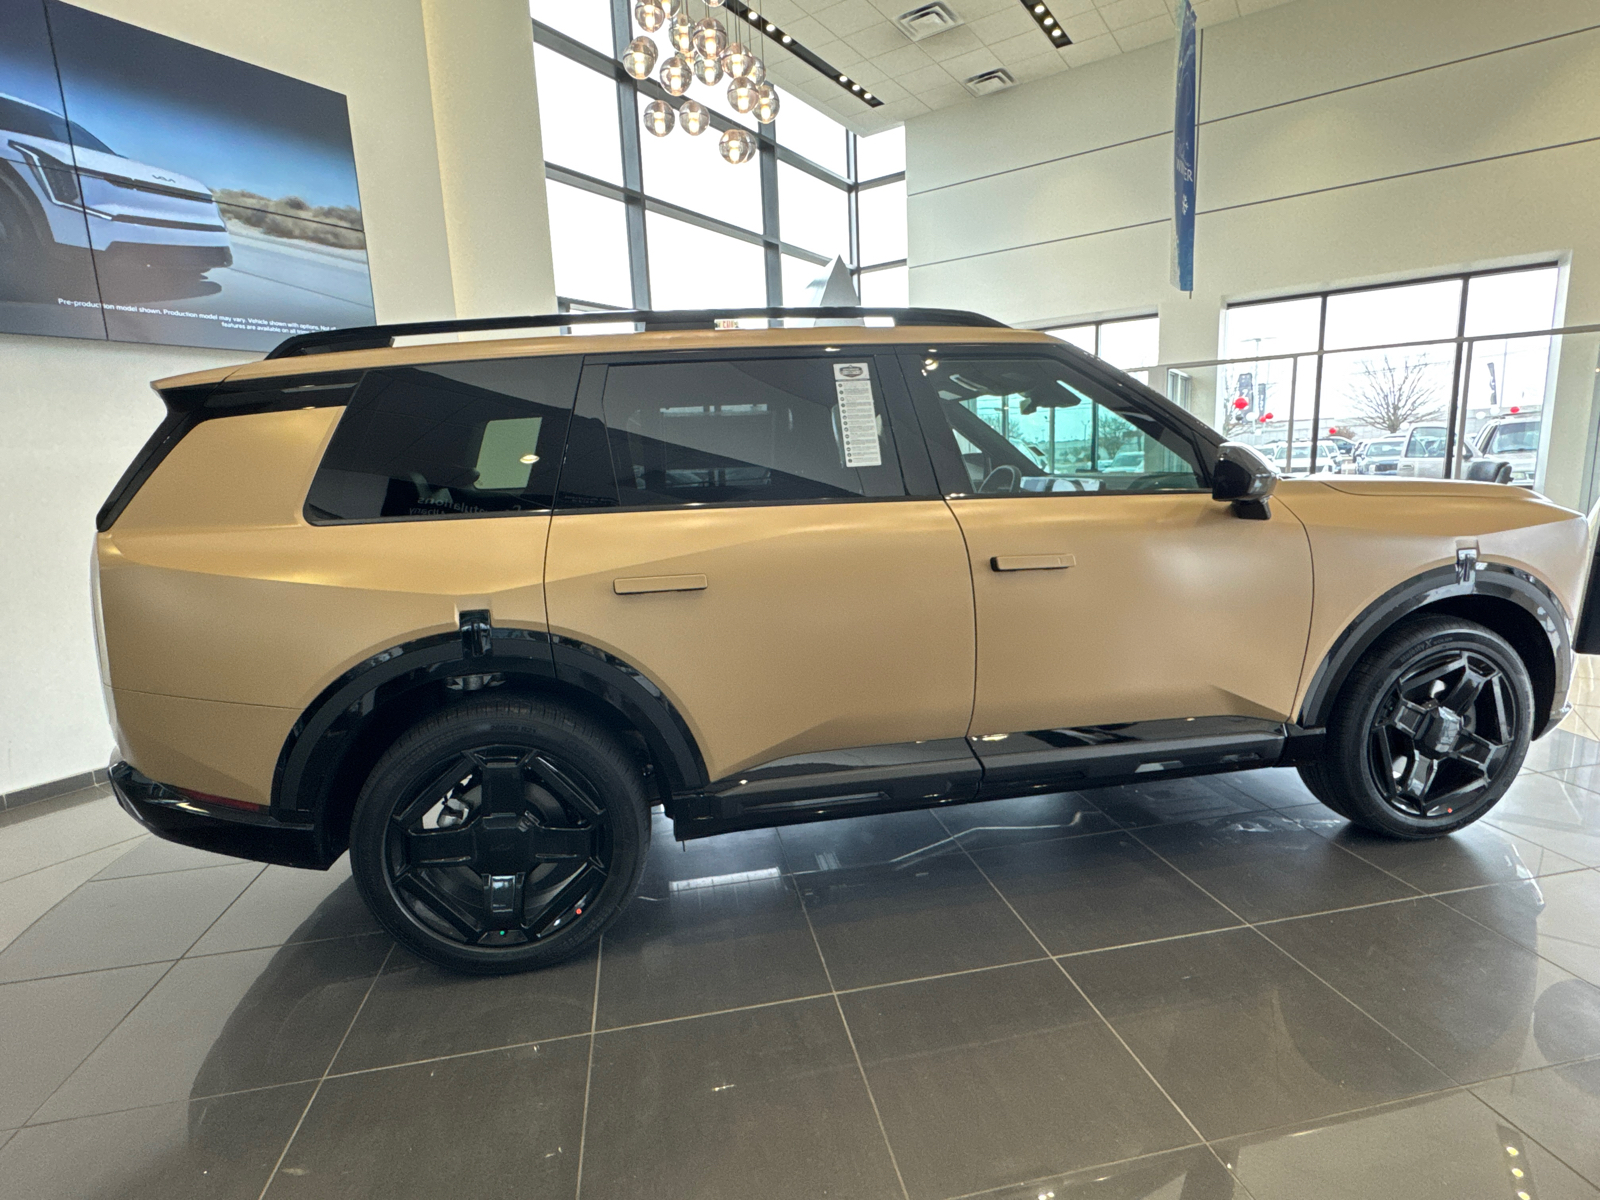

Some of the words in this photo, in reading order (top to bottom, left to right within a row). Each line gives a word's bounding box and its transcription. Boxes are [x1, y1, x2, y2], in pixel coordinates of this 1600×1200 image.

[116, 304, 138, 312] model
[139, 307, 162, 315] shown.
[163, 309, 198, 318] Production
[199, 313, 218, 321] model
[221, 322, 246, 330] features
[257, 325, 281, 333] available
